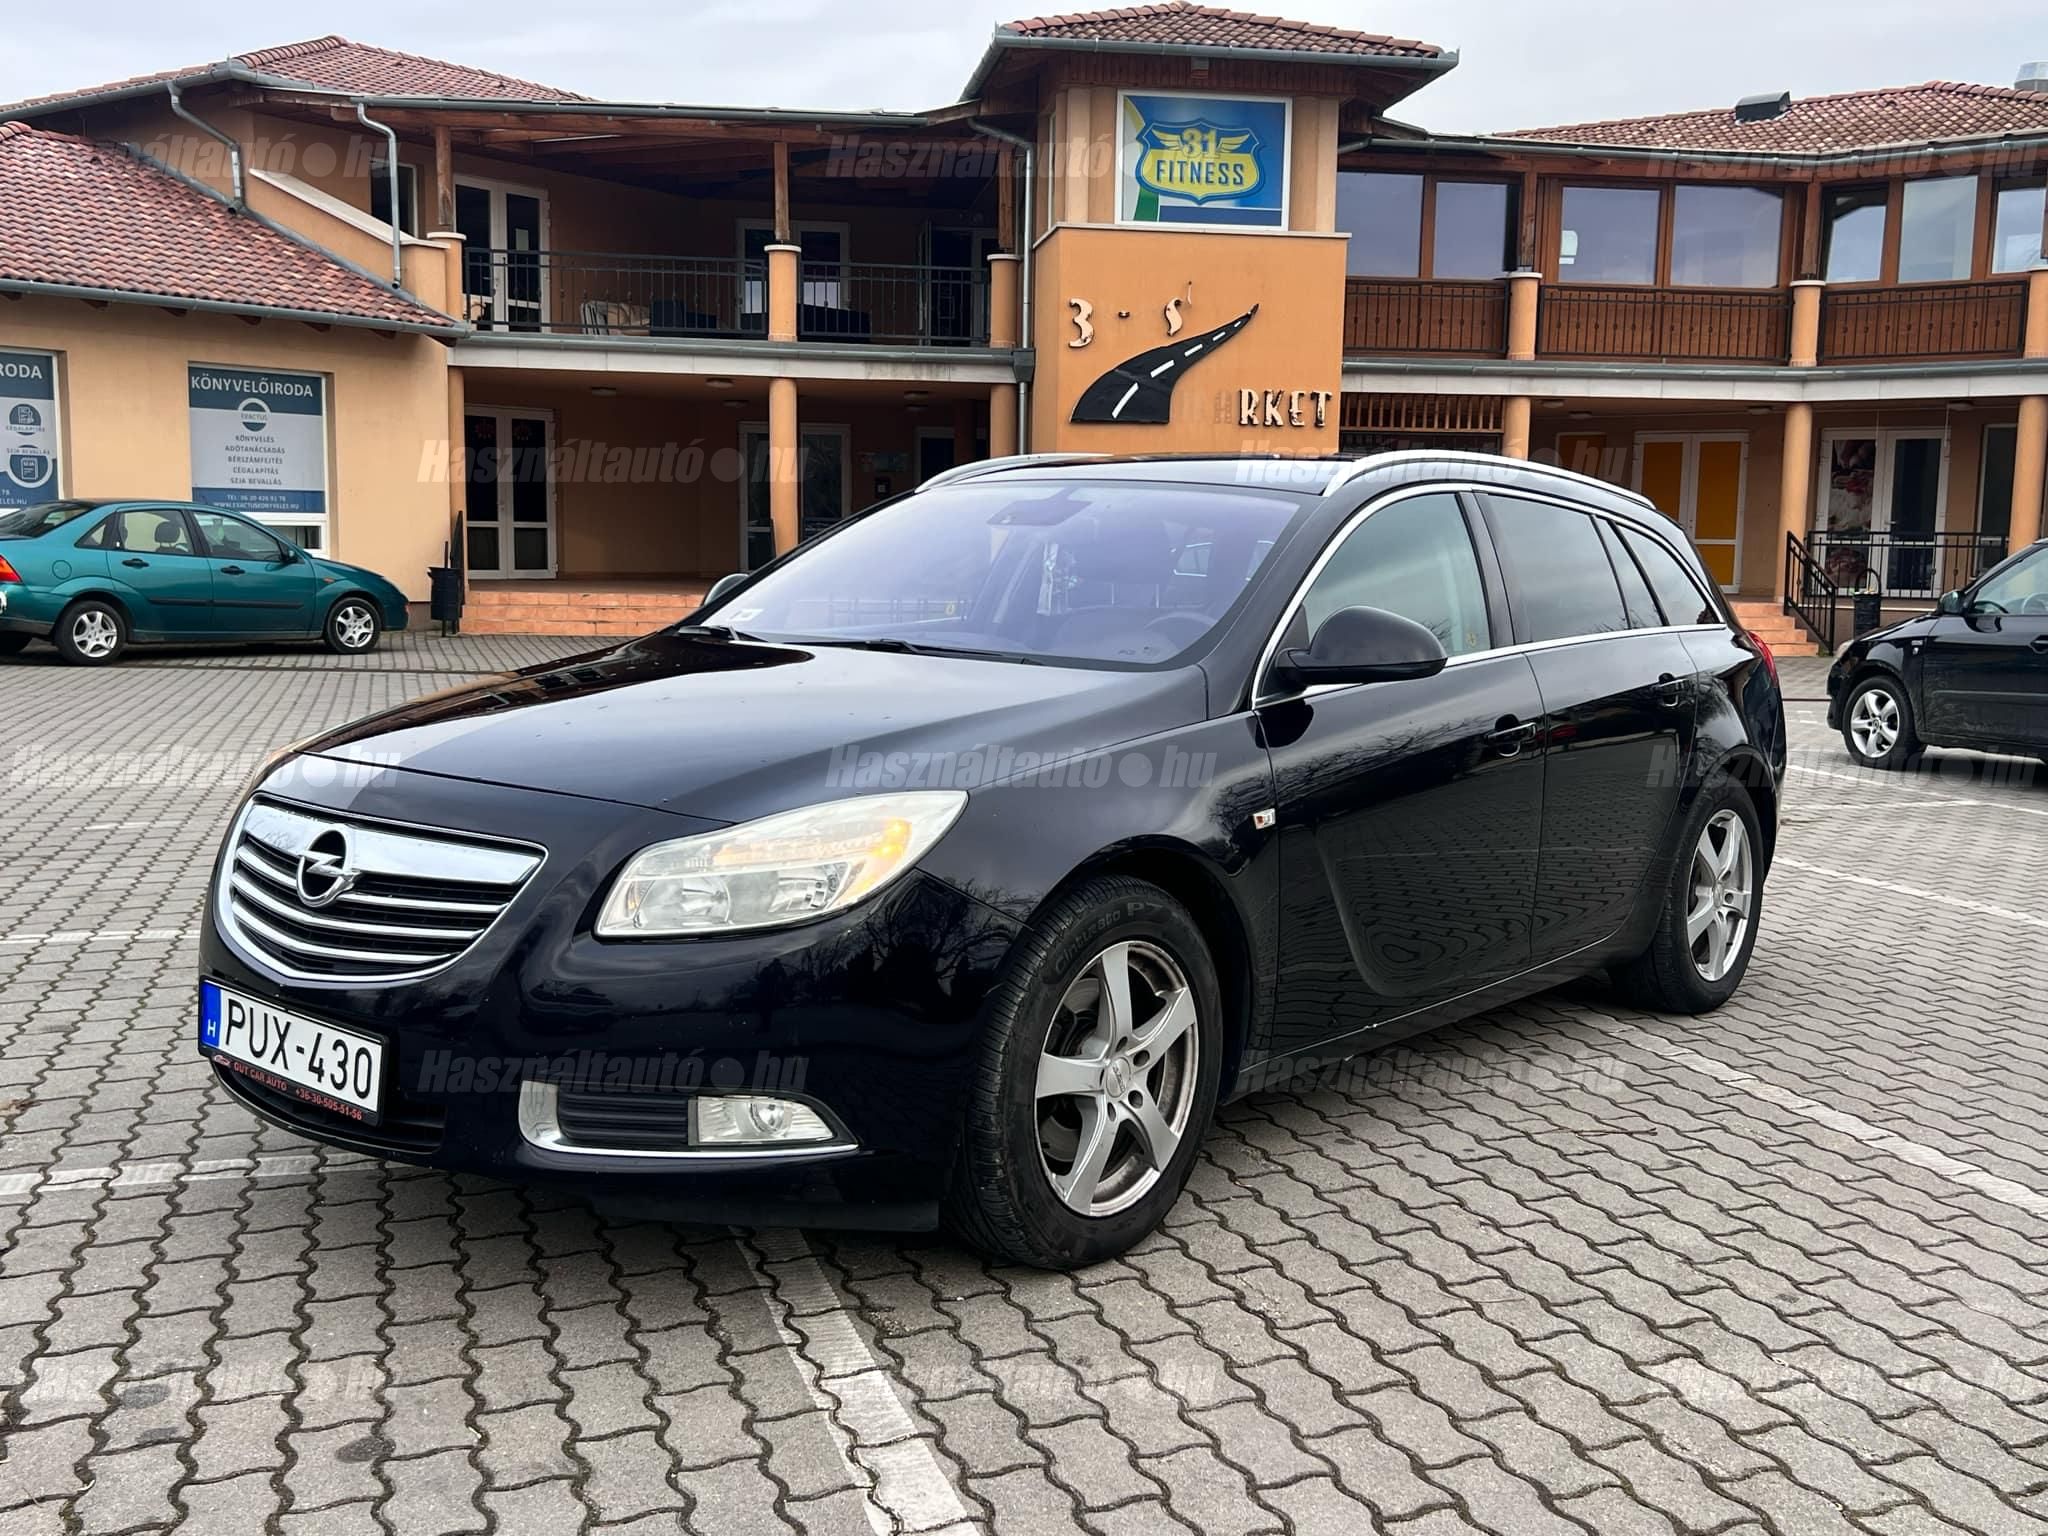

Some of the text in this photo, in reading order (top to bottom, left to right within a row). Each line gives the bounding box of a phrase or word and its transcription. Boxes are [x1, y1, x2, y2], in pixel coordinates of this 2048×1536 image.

[1181, 127, 1221, 158] 31
[1156, 159, 1245, 186] FITNESS
[191, 373, 313, 397] KÖNYVELŐIRODA
[235, 434, 275, 443] KÖNYVELÉS
[225, 444, 286, 454] ADÓTANÁCSADÁS
[227, 455, 283, 465] BÉRSZÁMFEJTÉS
[232, 466, 279, 475] CÉGALAPÍTÁS
[248, 477, 282, 486] BEVALLÁS
[207, 1019, 217, 1038] H
[225, 998, 372, 1099] PUX-430
[233, 1061, 288, 1091] GUT CAR AUTO
